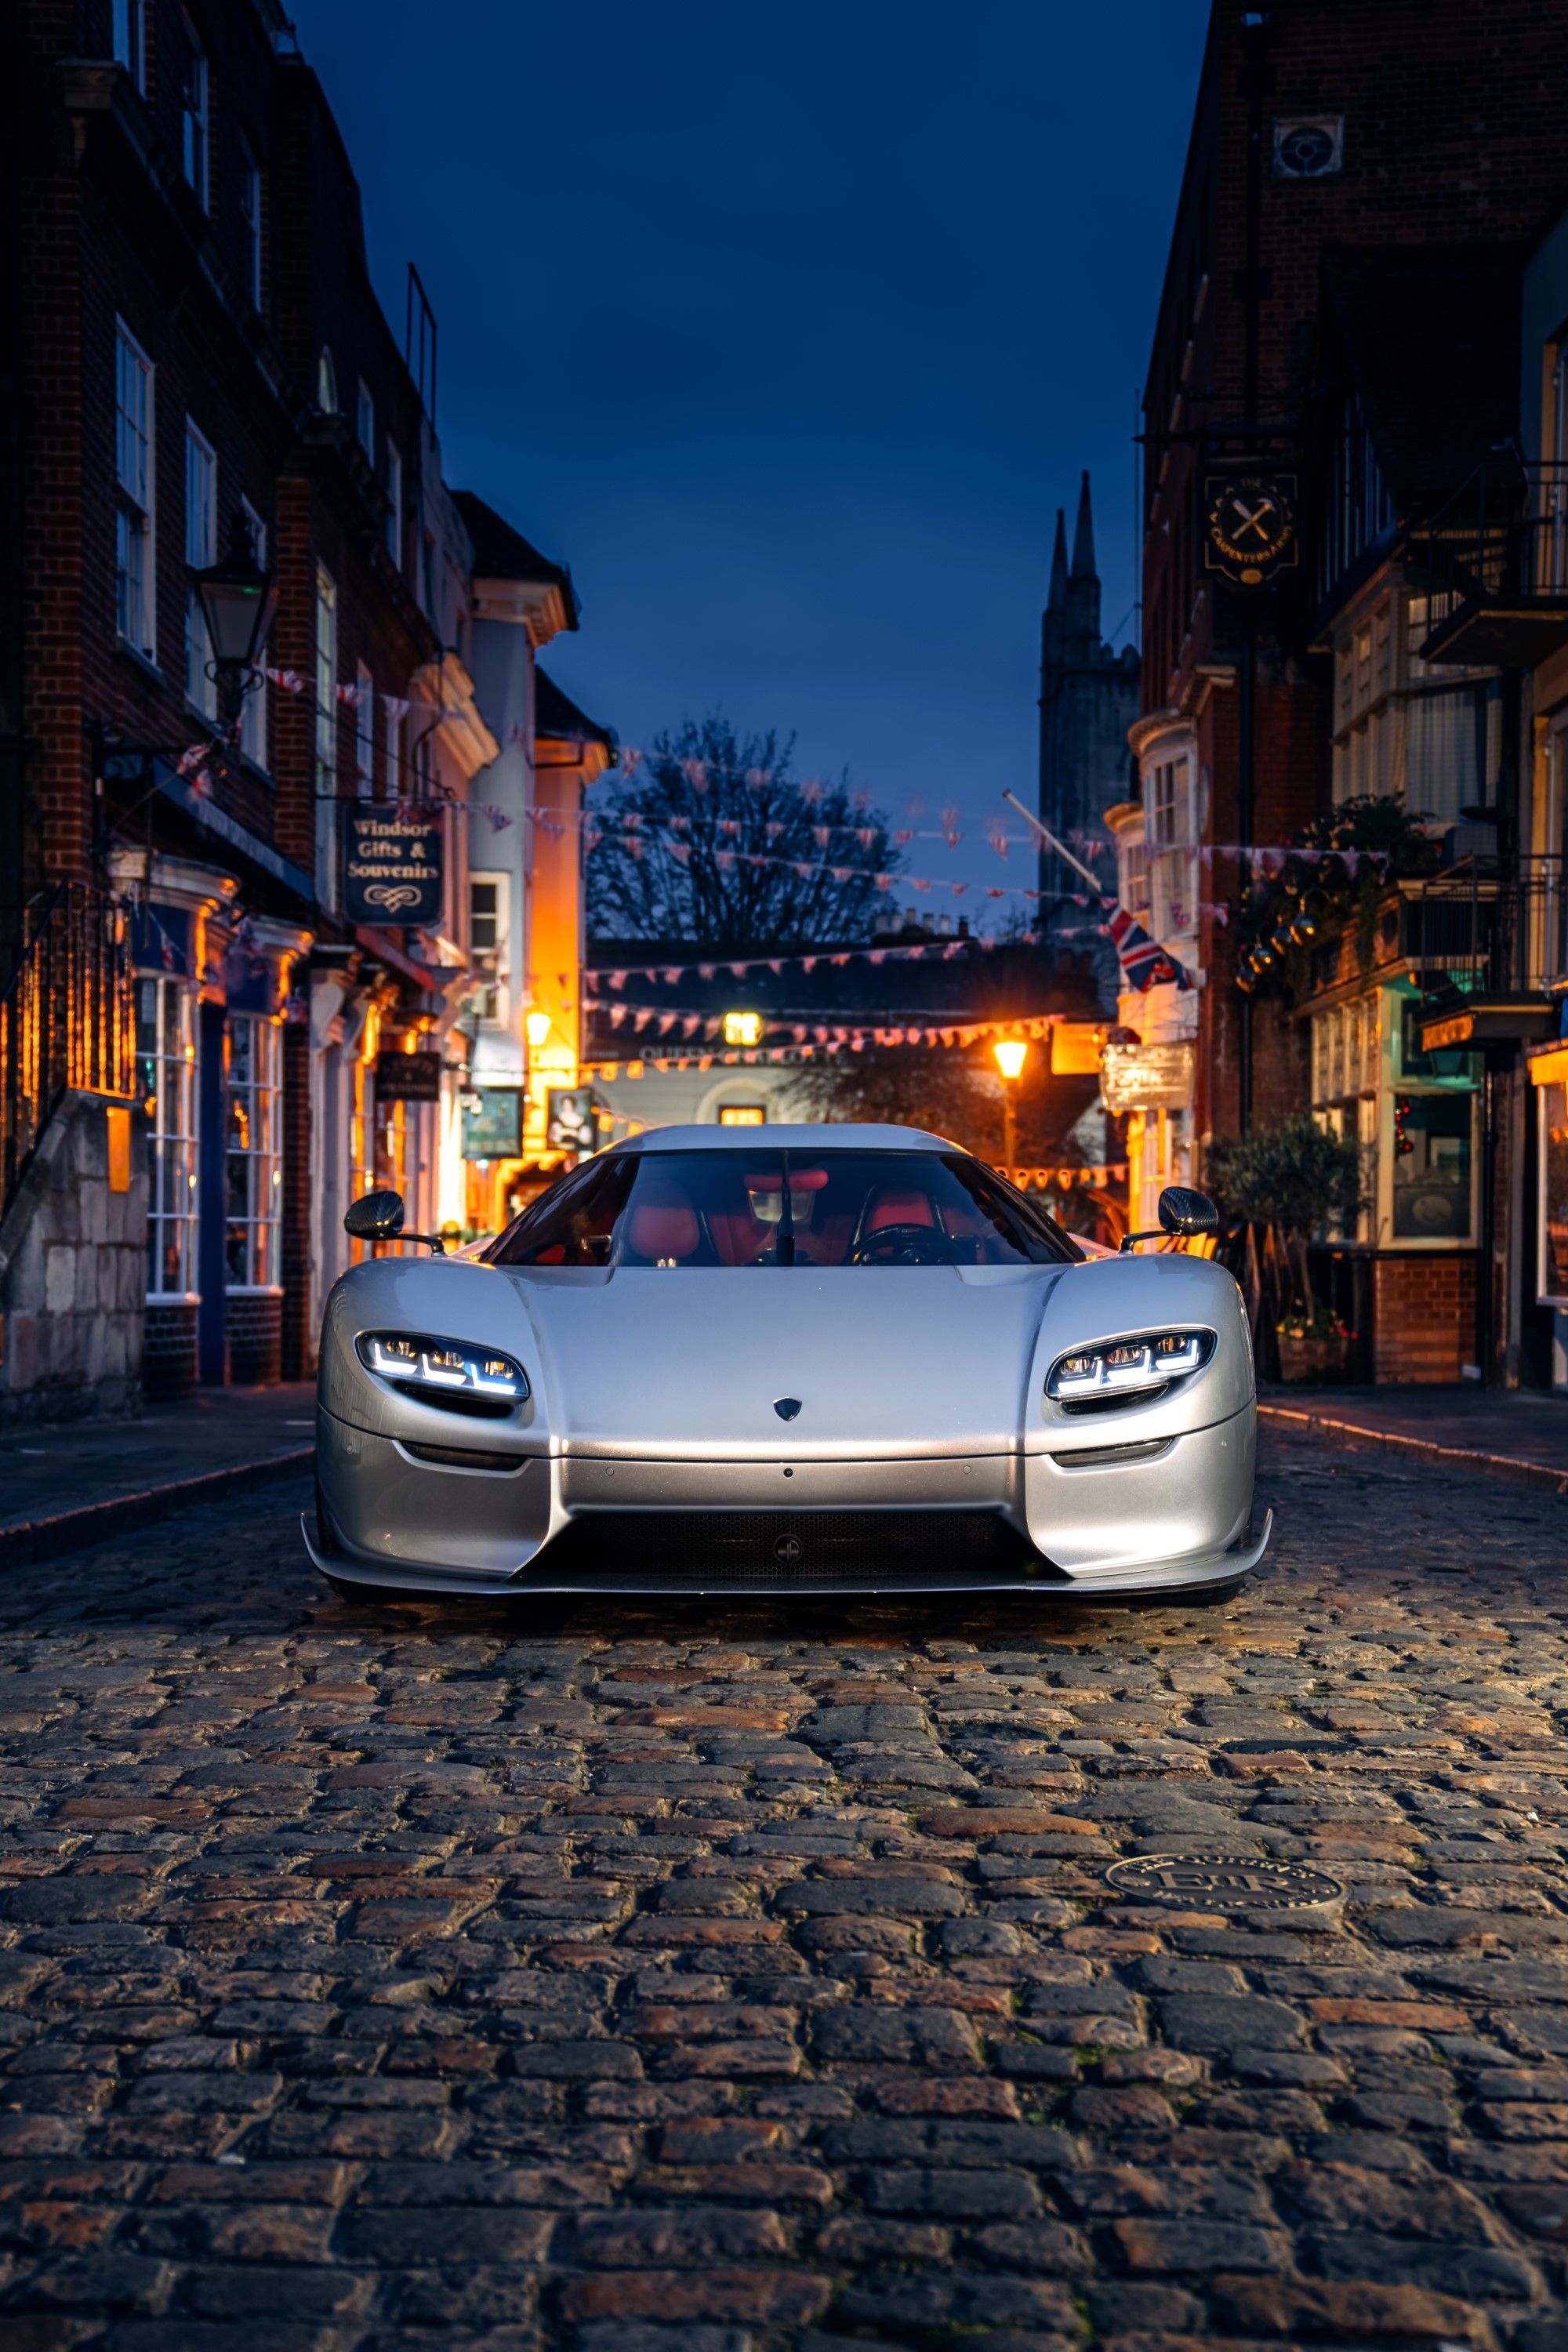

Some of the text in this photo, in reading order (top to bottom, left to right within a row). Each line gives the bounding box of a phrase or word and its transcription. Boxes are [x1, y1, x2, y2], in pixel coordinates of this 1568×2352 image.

[354, 819, 432, 837] Windsor
[358, 840, 426, 858] Gifts &
[348, 862, 439, 879] Souvenirs
